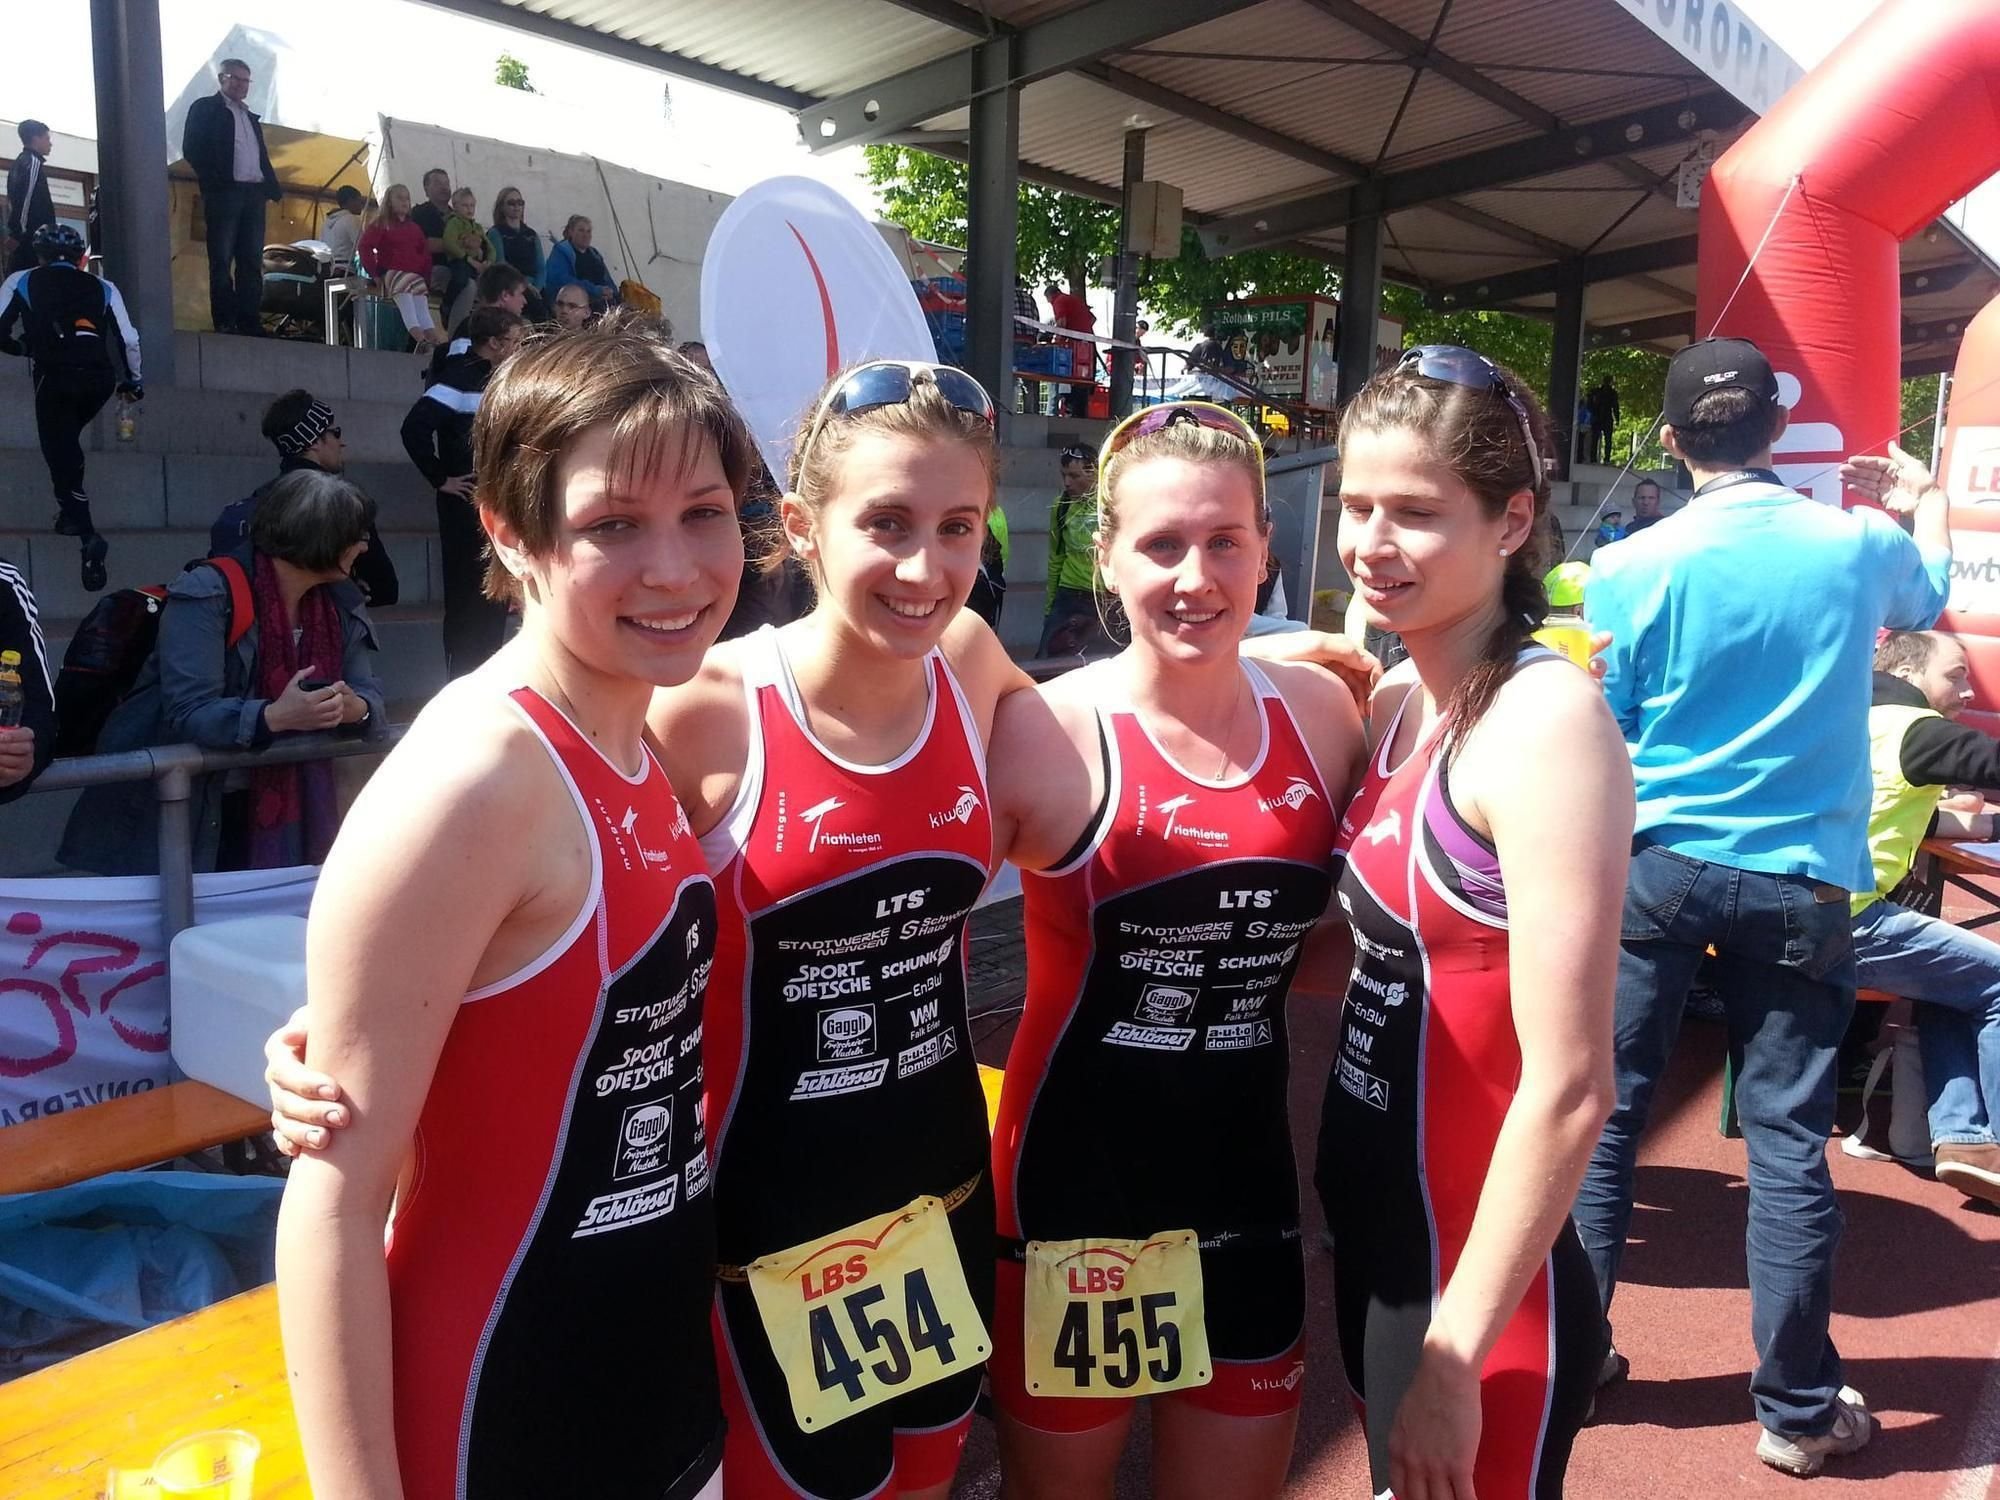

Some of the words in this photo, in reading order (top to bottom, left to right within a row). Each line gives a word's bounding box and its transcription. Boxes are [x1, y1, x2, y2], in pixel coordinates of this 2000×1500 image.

[1262, 310, 1291, 321] PILS
[928, 793, 978, 829] kiwami
[1256, 785, 1309, 813] kiwami
[875, 889, 927, 919] LTS
[1219, 890, 1272, 909] LTS
[778, 927, 891, 950] STADTWERKE
[917, 922, 947, 937] Haus
[1119, 921, 1235, 937] STADTWERKE
[1159, 931, 1232, 944] MENGEN
[816, 937, 888, 957] MENGEN
[1127, 948, 1205, 962] SPORT
[788, 960, 865, 983] SPORT
[881, 948, 938, 980] SCHUNK
[1120, 953, 1205, 977] DIETSCHE
[1218, 951, 1283, 970] SCHUNK
[783, 976, 872, 1002] DIETSCHE
[913, 973, 942, 997] EnBW
[1148, 990, 1188, 1009] Gaggli
[826, 1014, 867, 1038] Gaggli
[1353, 1001, 1388, 1028] EnBW
[910, 1028, 926, 1041] Falk
[1208, 1036, 1251, 1049] domicil
[606, 1034, 674, 1072] SPORT
[596, 1055, 674, 1097] DIETSCHE
[792, 1066, 884, 1094] Schlösser
[628, 1110, 667, 1142] Gaggli
[801, 1254, 868, 1302] LBS
[1068, 1266, 1126, 1294] LBS
[808, 1267, 957, 1403] 454
[1052, 1291, 1183, 1388] 455
